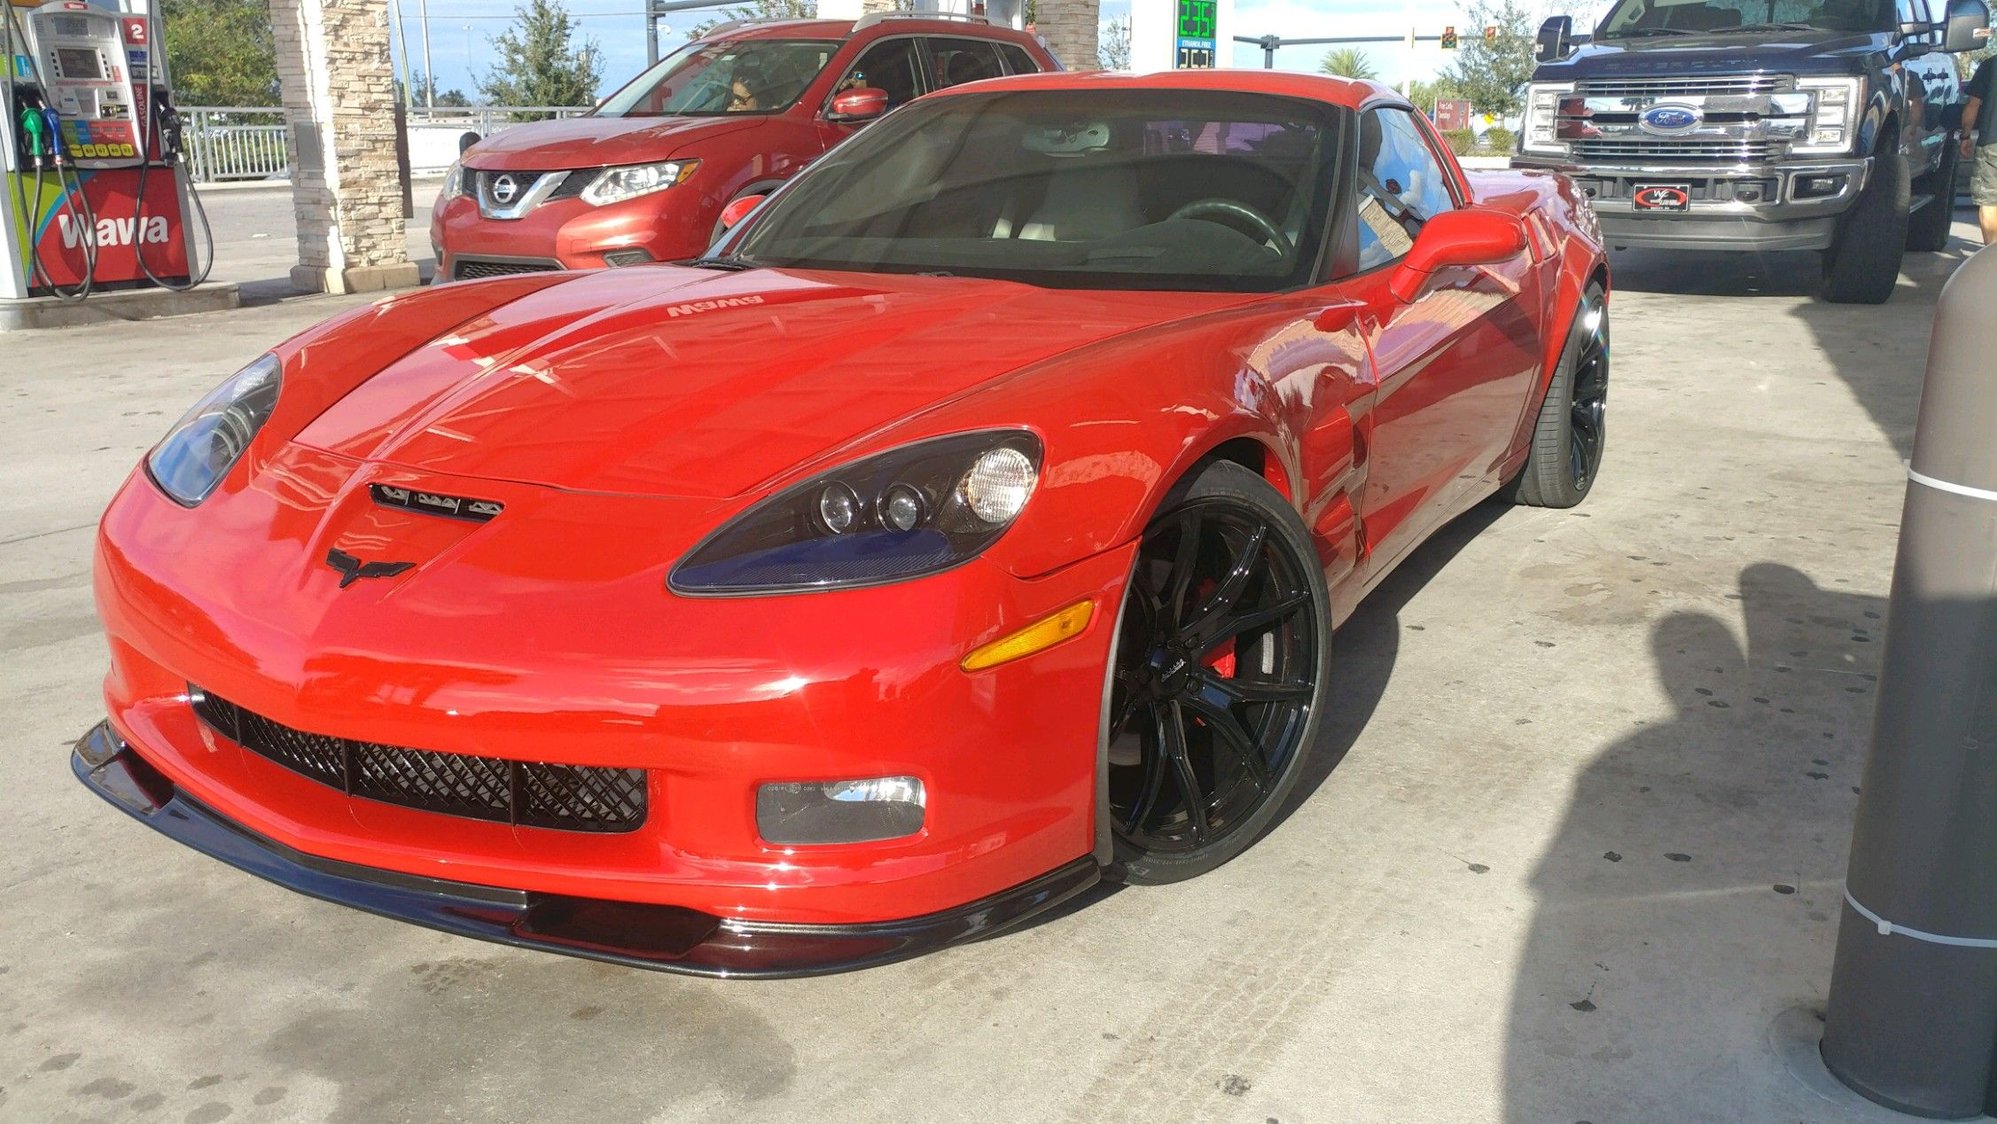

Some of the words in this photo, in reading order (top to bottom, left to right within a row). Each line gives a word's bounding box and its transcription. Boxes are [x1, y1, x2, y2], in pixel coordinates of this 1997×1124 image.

[131, 23, 144, 40] 2
[1655, 111, 1687, 126] Ford
[57, 212, 169, 249] Wawa
